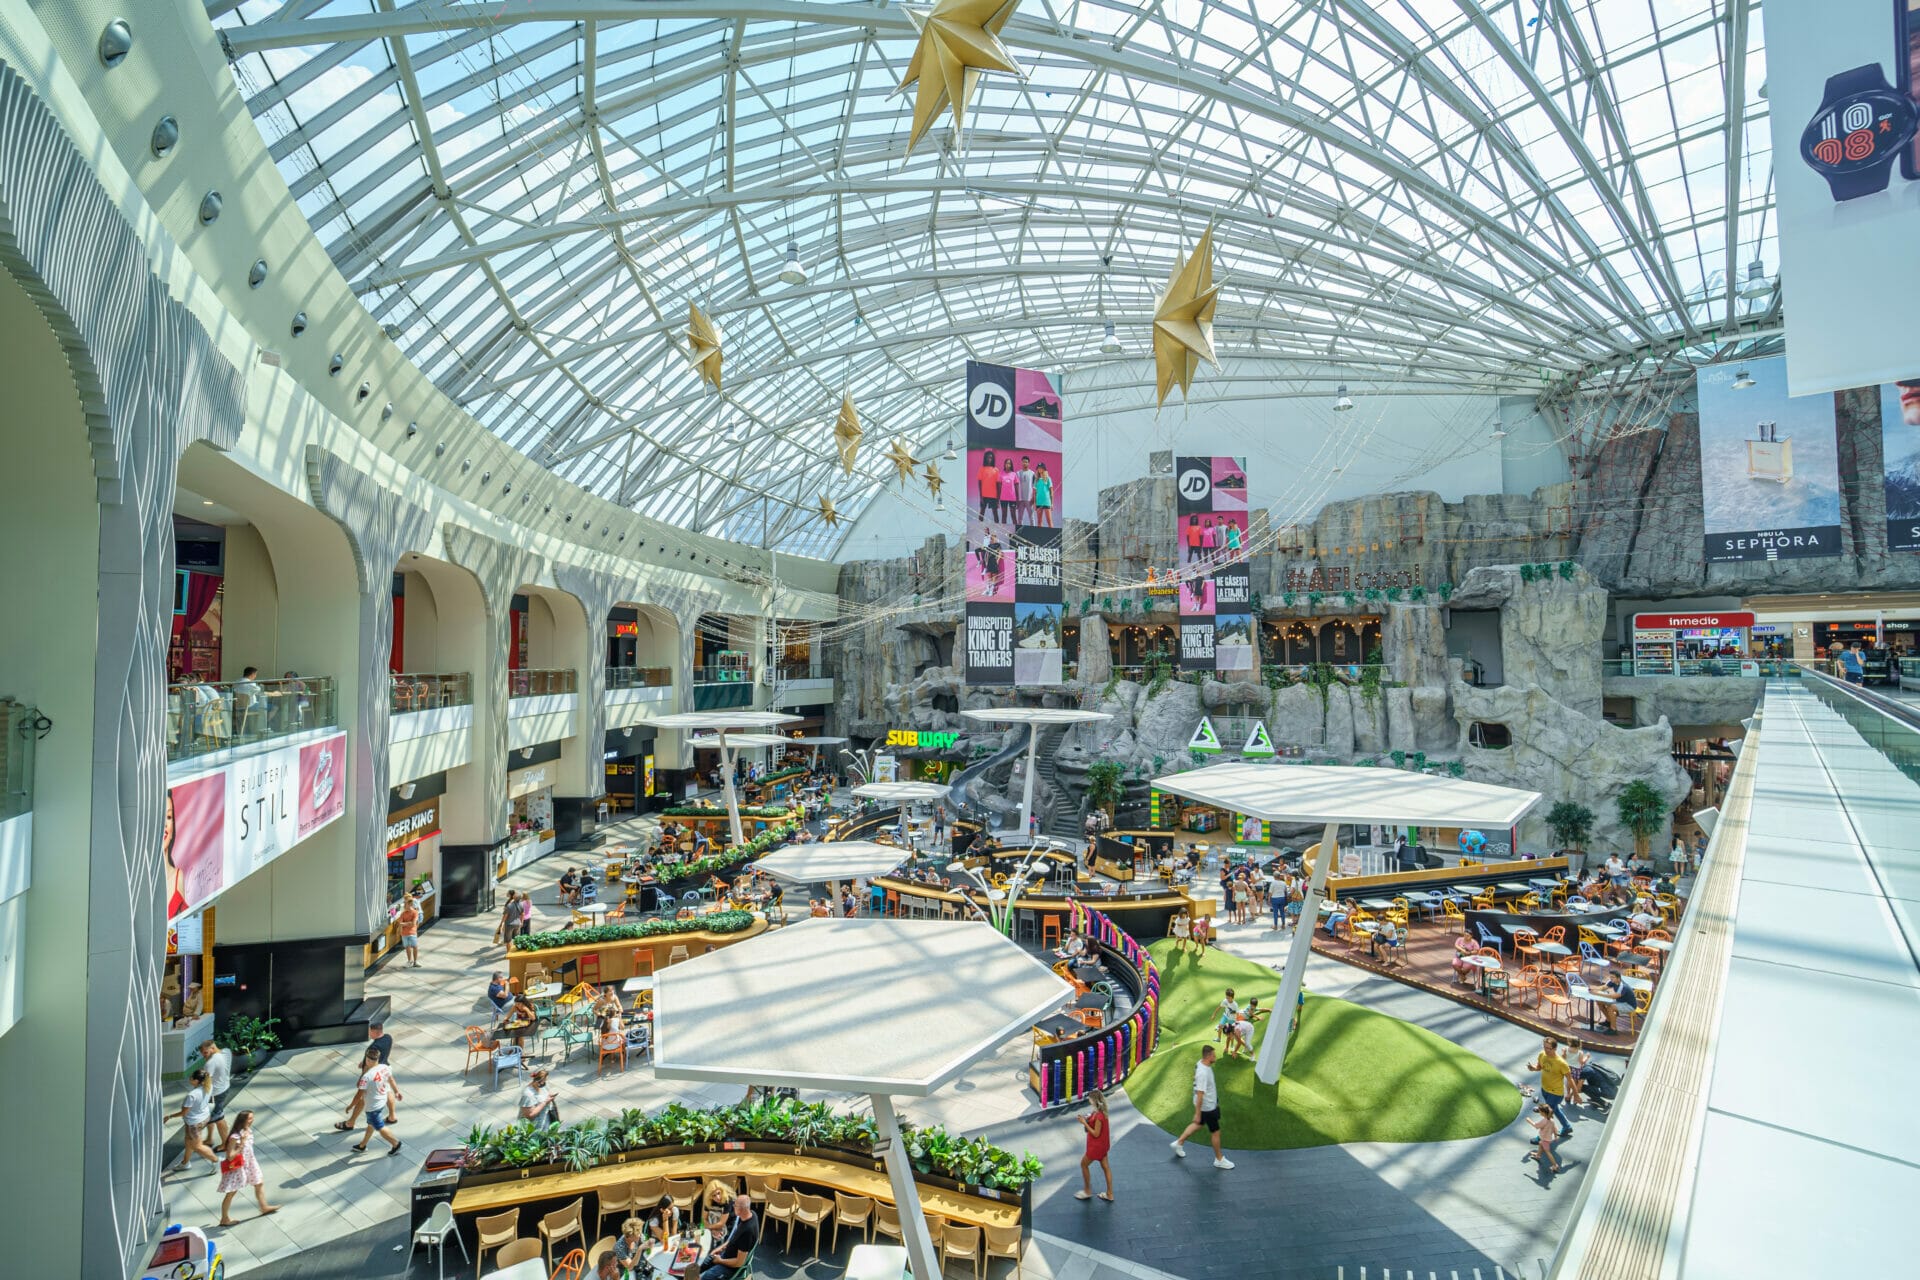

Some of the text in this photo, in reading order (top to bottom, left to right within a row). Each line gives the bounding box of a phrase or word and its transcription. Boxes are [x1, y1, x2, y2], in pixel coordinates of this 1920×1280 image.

[975, 393, 1007, 418] JD
[1183, 477, 1206, 493] JD
[1725, 534, 1820, 551] SEPHORA
[1216, 588, 1224, 598] LA
[967, 615, 1013, 630] UNDISPUTED
[1181, 624, 1214, 634] UNDISPUTED
[1669, 616, 1719, 626] inmedio
[967, 630, 1013, 651] KING OF
[1181, 634, 1214, 647] KING OF
[967, 650, 1013, 667] TRAINERS
[1182, 647, 1215, 658] TRAINERS
[885, 729, 960, 749] SUBWAY
[240, 788, 287, 841] STIL
[386, 808, 435, 843] RGER KING
